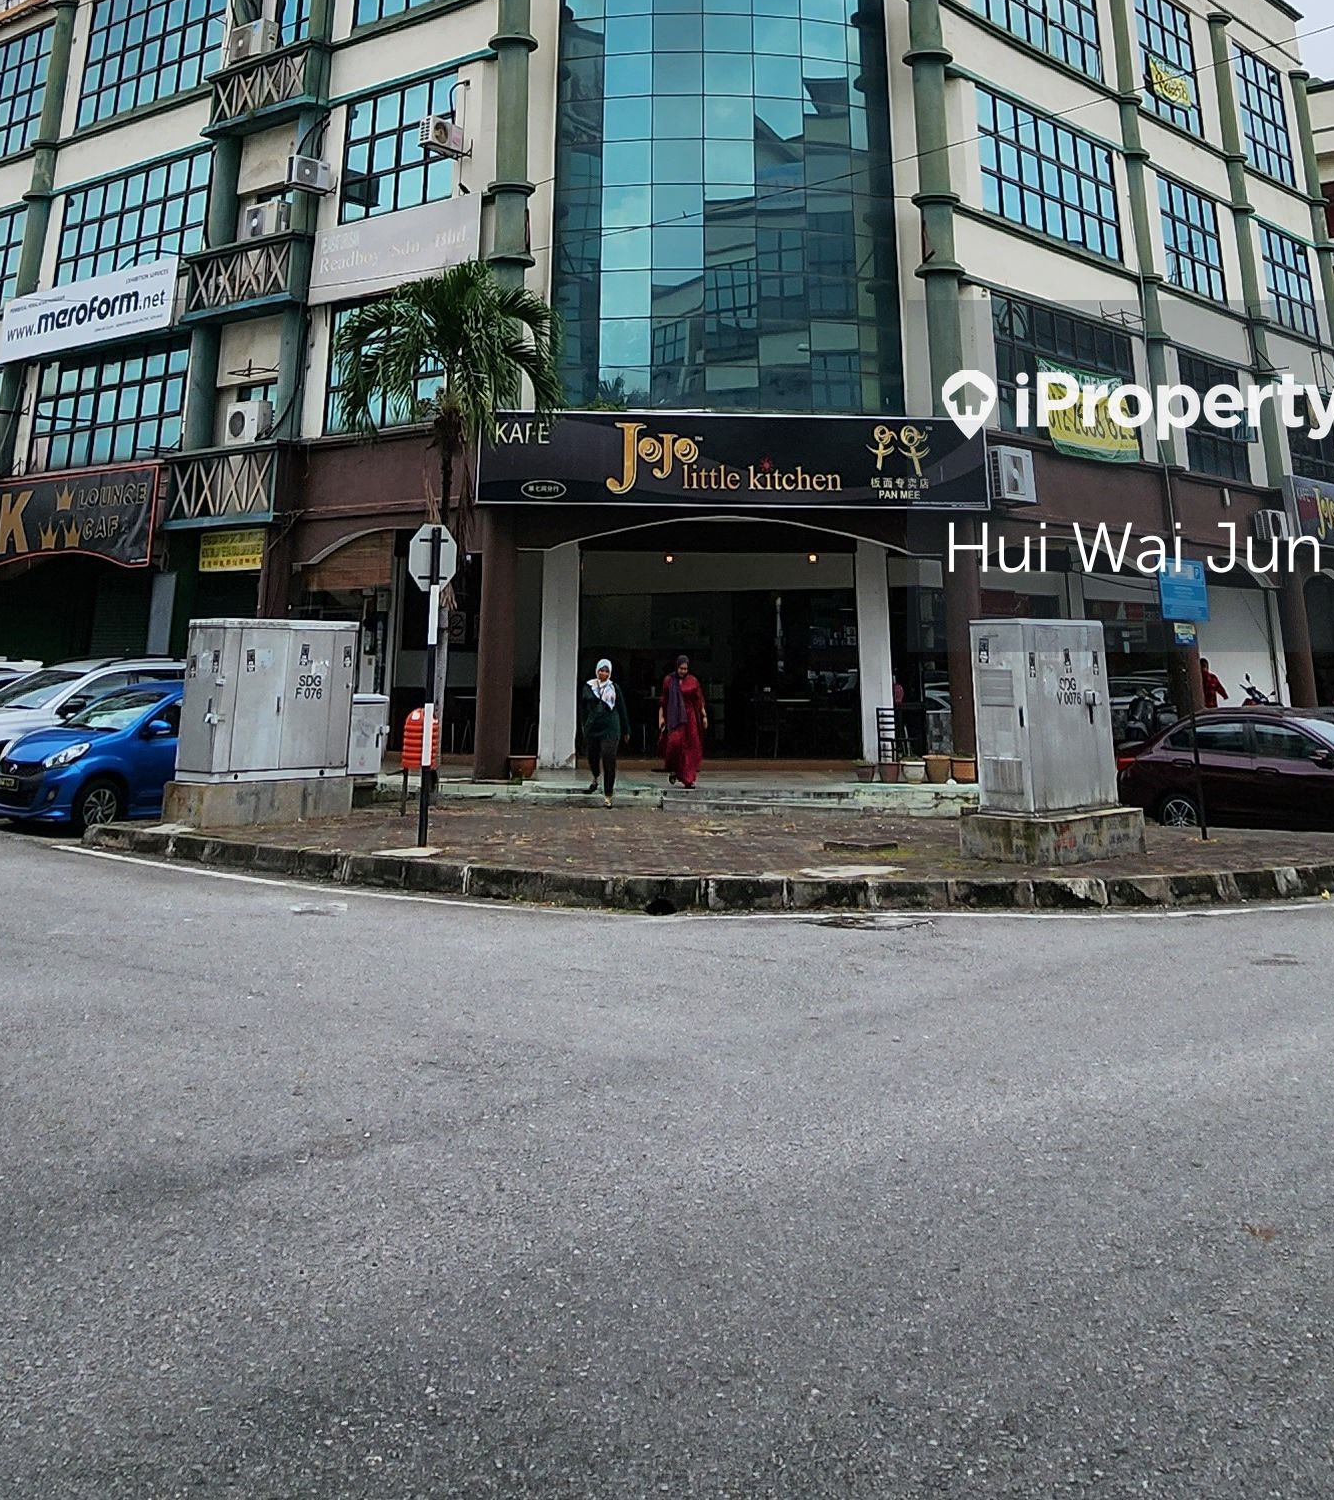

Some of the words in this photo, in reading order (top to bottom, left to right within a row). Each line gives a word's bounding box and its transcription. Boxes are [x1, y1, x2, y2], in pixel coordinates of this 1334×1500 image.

[682, 463, 741, 491] little
[748, 463, 843, 492] kitchen
[878, 490, 898, 500] PAN
[900, 490, 921, 500] MEE
[82, 514, 130, 541] CAF
[299, 675, 322, 687] SDG
[295, 688, 302, 699] F
[304, 688, 322, 699] 076
[1064, 692, 1082, 705] 0076
